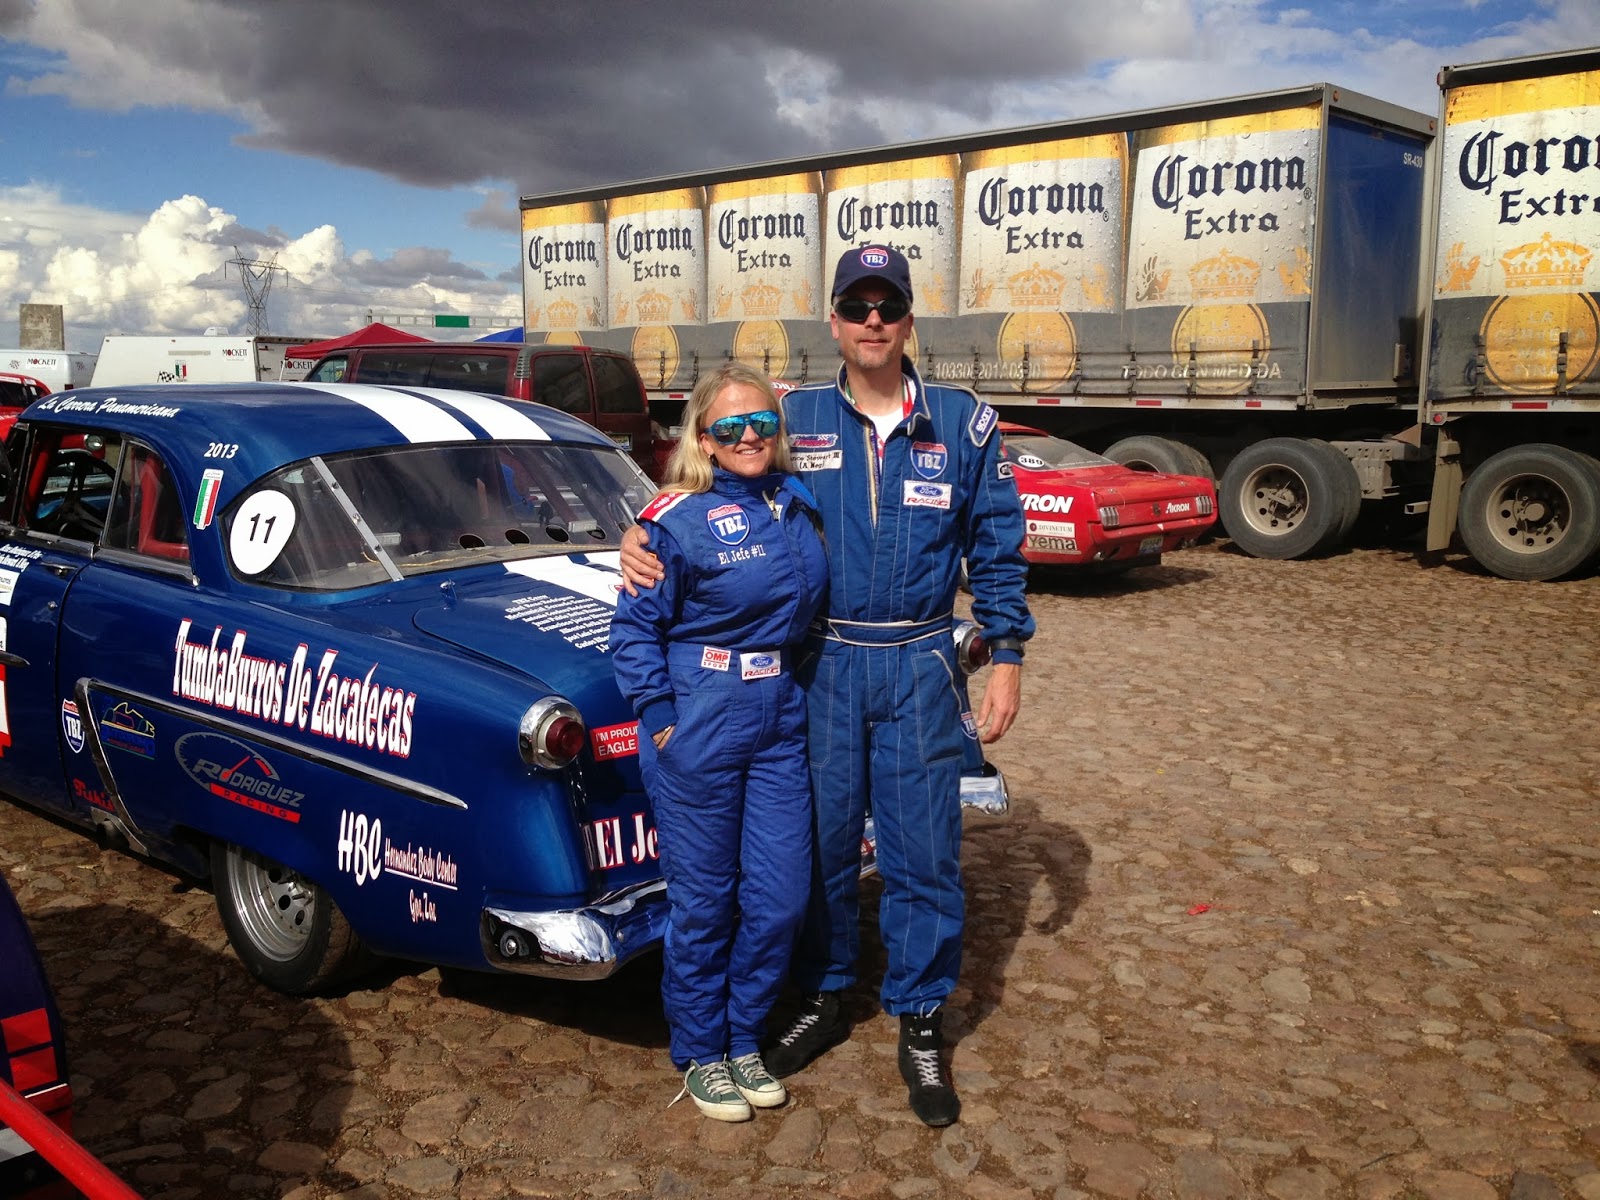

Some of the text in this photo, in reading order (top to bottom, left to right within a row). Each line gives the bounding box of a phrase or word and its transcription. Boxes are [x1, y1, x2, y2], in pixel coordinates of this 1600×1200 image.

[1459, 130, 1600, 195] Coro
[1152, 154, 1307, 214] Corona
[978, 176, 1105, 230] Corona
[718, 209, 806, 253] Corona
[837, 197, 940, 244] Corona
[1184, 208, 1280, 242] Extra
[616, 223, 693, 264] Corona
[1005, 226, 1085, 255] Extra
[528, 235, 597, 273] Corona
[737, 249, 792, 273] Extra
[866, 254, 884, 265] TBZ
[544, 270, 587, 291] Extra
[633, 260, 682, 282] Extra
[27, 358, 57, 367] MOCKETT
[1213, 362, 1282, 379] MEDDA
[37, 396, 181, 418] La Carrera Panamericana
[203, 442, 239, 459] 2013
[917, 453, 942, 470] TBZ
[1020, 456, 1043, 465] 389
[906, 497, 949, 507] RACING
[919, 486, 938, 496] Ford
[1165, 502, 1190, 514] AKRON
[249, 512, 277, 544] 11
[715, 515, 746, 537] TBZ
[1038, 524, 1073, 533] DIVINETUM
[718, 544, 767, 565] El Jefe #11
[1028, 536, 1077, 551] Yema
[703, 661, 727, 669] SPORT
[705, 651, 728, 662] OMP
[754, 657, 769, 666] Ford
[744, 666, 779, 677] RACING
[172, 617, 417, 759] TumbaBurros De Zacatecas
[66, 716, 82, 740] TBZ
[595, 731, 609, 742] I'M
[598, 739, 636, 757] EAGLE
[191, 758, 305, 808] RODRIGUEZ
[223, 789, 289, 819] RACING
[338, 809, 382, 886] HBC
[593, 812, 659, 870] El Je
[418, 846, 435, 885] Body
[436, 851, 457, 884] Center
